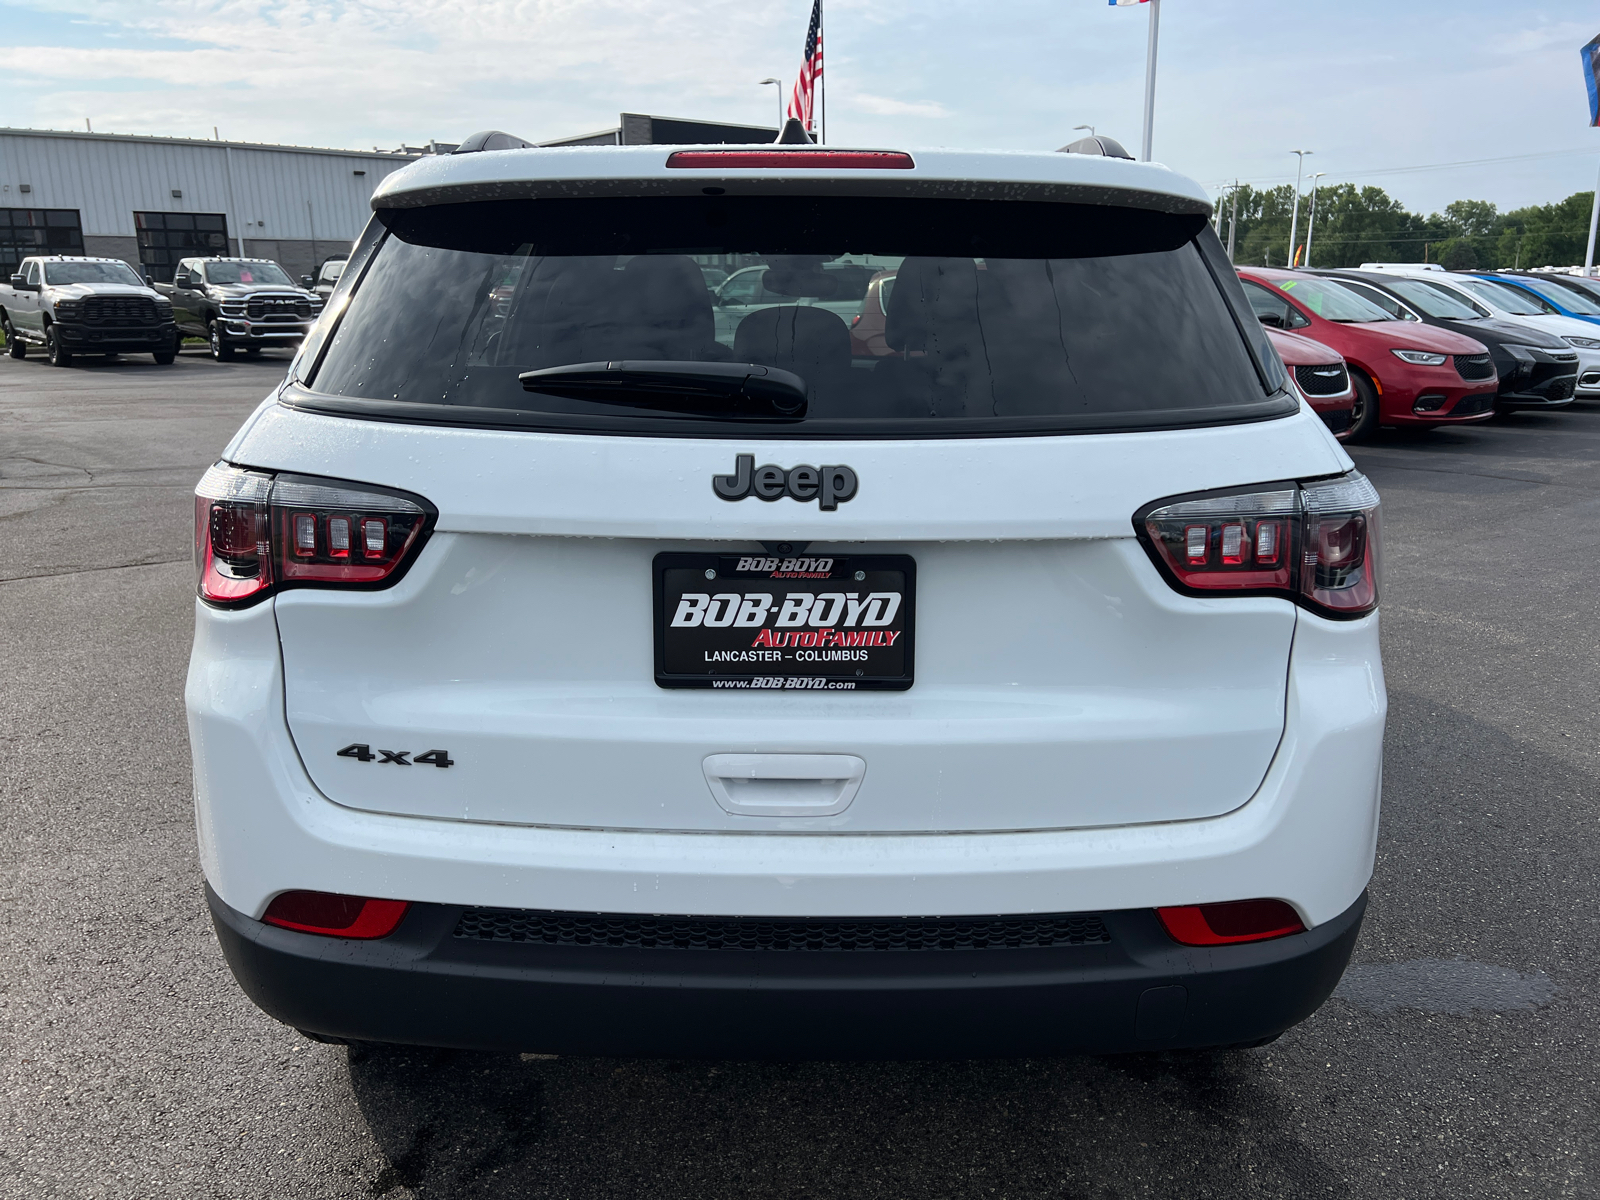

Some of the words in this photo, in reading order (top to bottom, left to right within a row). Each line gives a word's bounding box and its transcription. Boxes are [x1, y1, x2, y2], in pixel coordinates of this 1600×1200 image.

[711, 453, 859, 511] Jeep
[736, 557, 834, 572] BOB-BOYD
[670, 592, 902, 628] BOB-BOYD
[704, 650, 782, 662] LANCASTER
[795, 650, 868, 662] COLUMBUS
[712, 677, 856, 690] www.BOB-BOYD.com
[336, 743, 455, 769] 4x4
